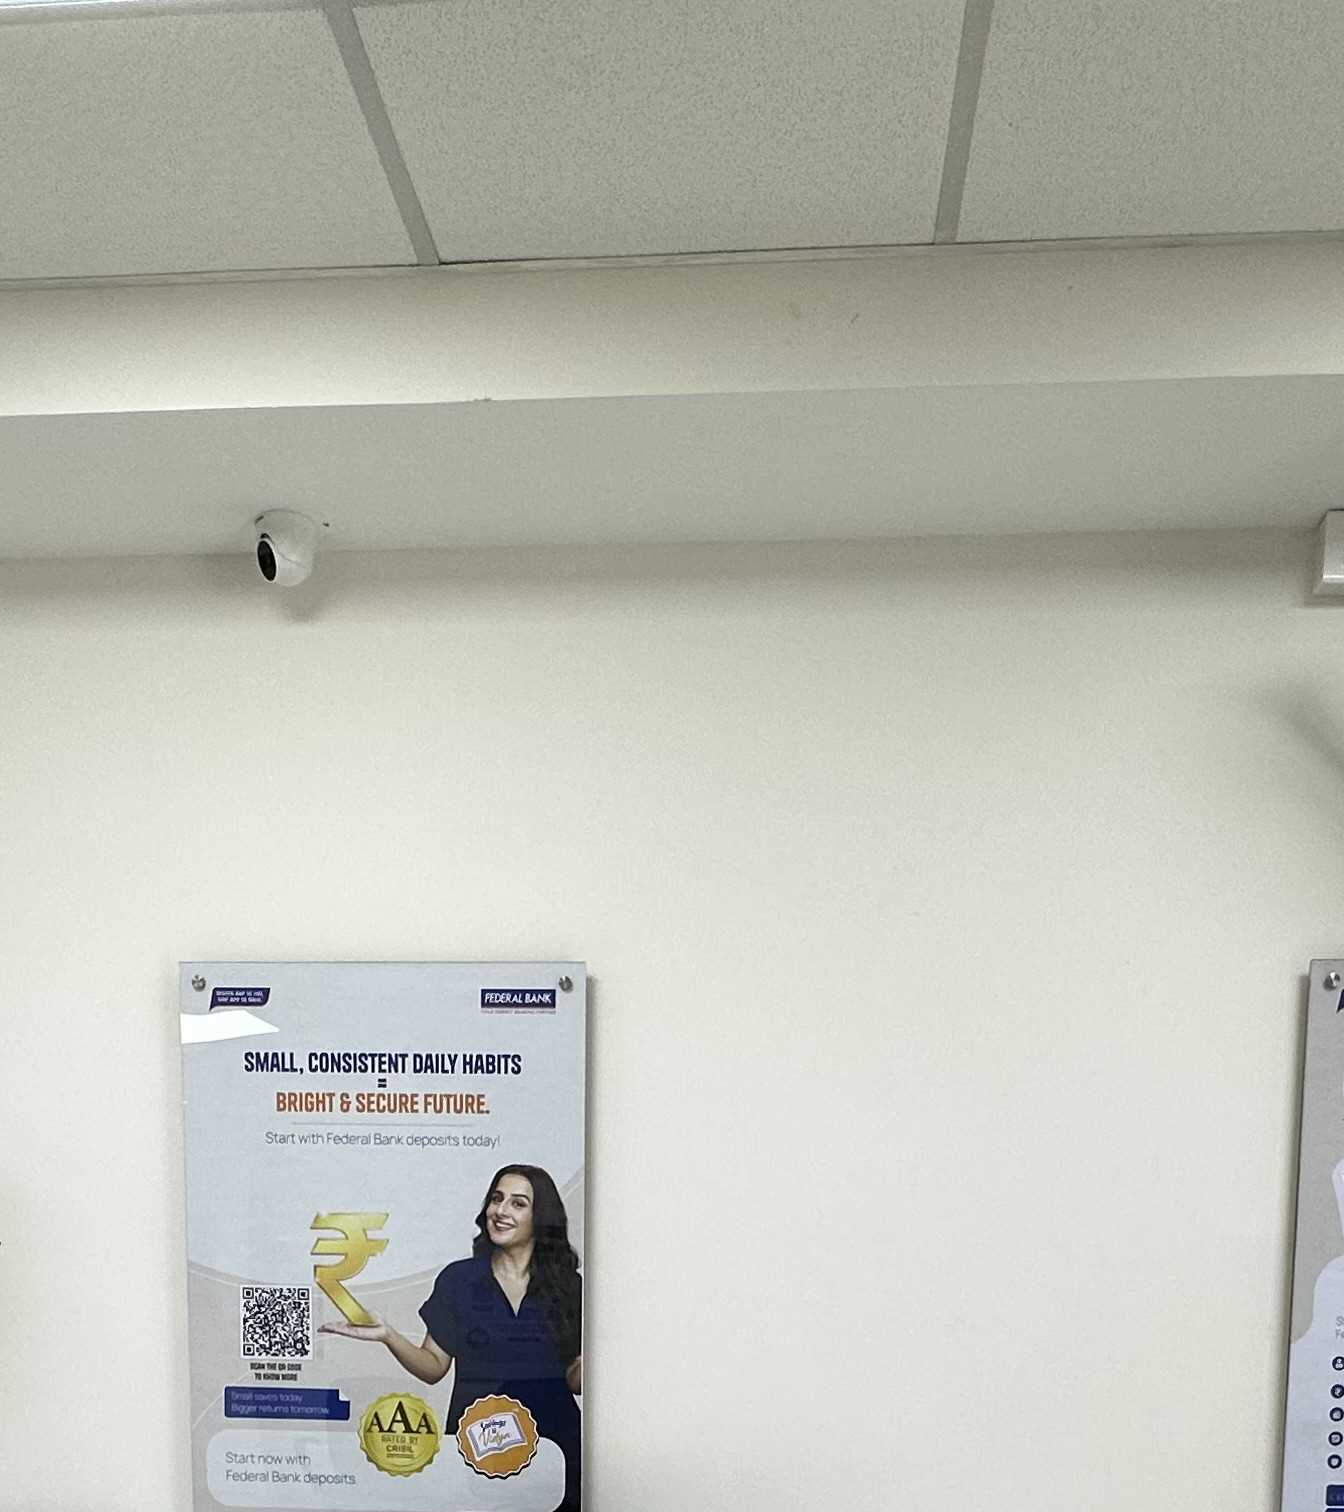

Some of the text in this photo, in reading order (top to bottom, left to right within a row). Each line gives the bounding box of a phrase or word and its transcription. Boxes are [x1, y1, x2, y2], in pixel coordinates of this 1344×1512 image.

[485, 992, 551, 1003] FEDERAL BANK
[244, 1051, 521, 1075] SMALL, CONSISTENT DAILY HABITS
[276, 1092, 490, 1114] BRIGHT & SECURE FUTURE.
[266, 1131, 500, 1150] Start with Federal Bank deposits today!
[280, 1393, 303, 1404] today
[290, 1406, 329, 1414] tomorrow
[366, 1400, 434, 1434] AAA
[225, 1452, 311, 1465] Start now with
[226, 1469, 356, 1485] Federal Bank deposits
